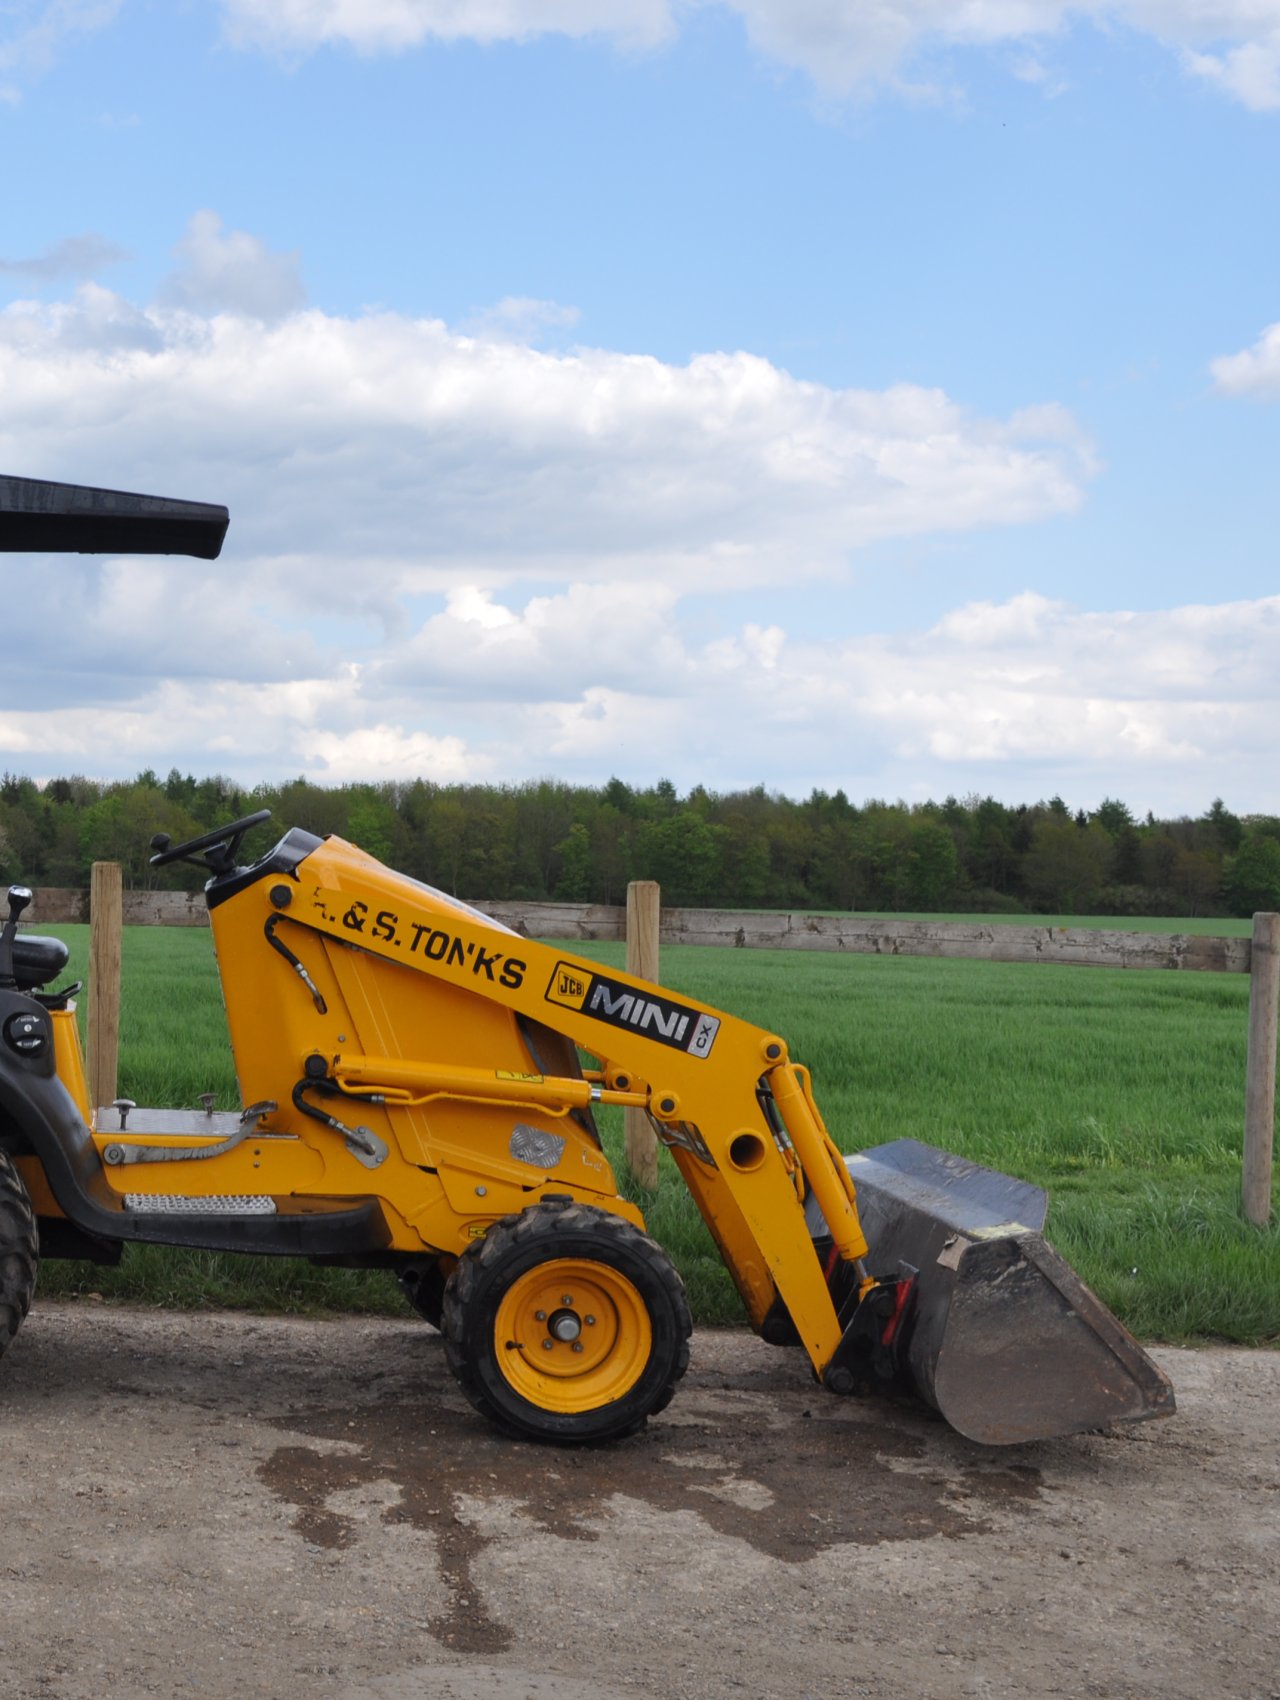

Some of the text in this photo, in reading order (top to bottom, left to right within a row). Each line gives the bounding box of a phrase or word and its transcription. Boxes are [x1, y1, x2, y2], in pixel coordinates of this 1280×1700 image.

[560, 975, 712, 1049] JCB MINI CX
